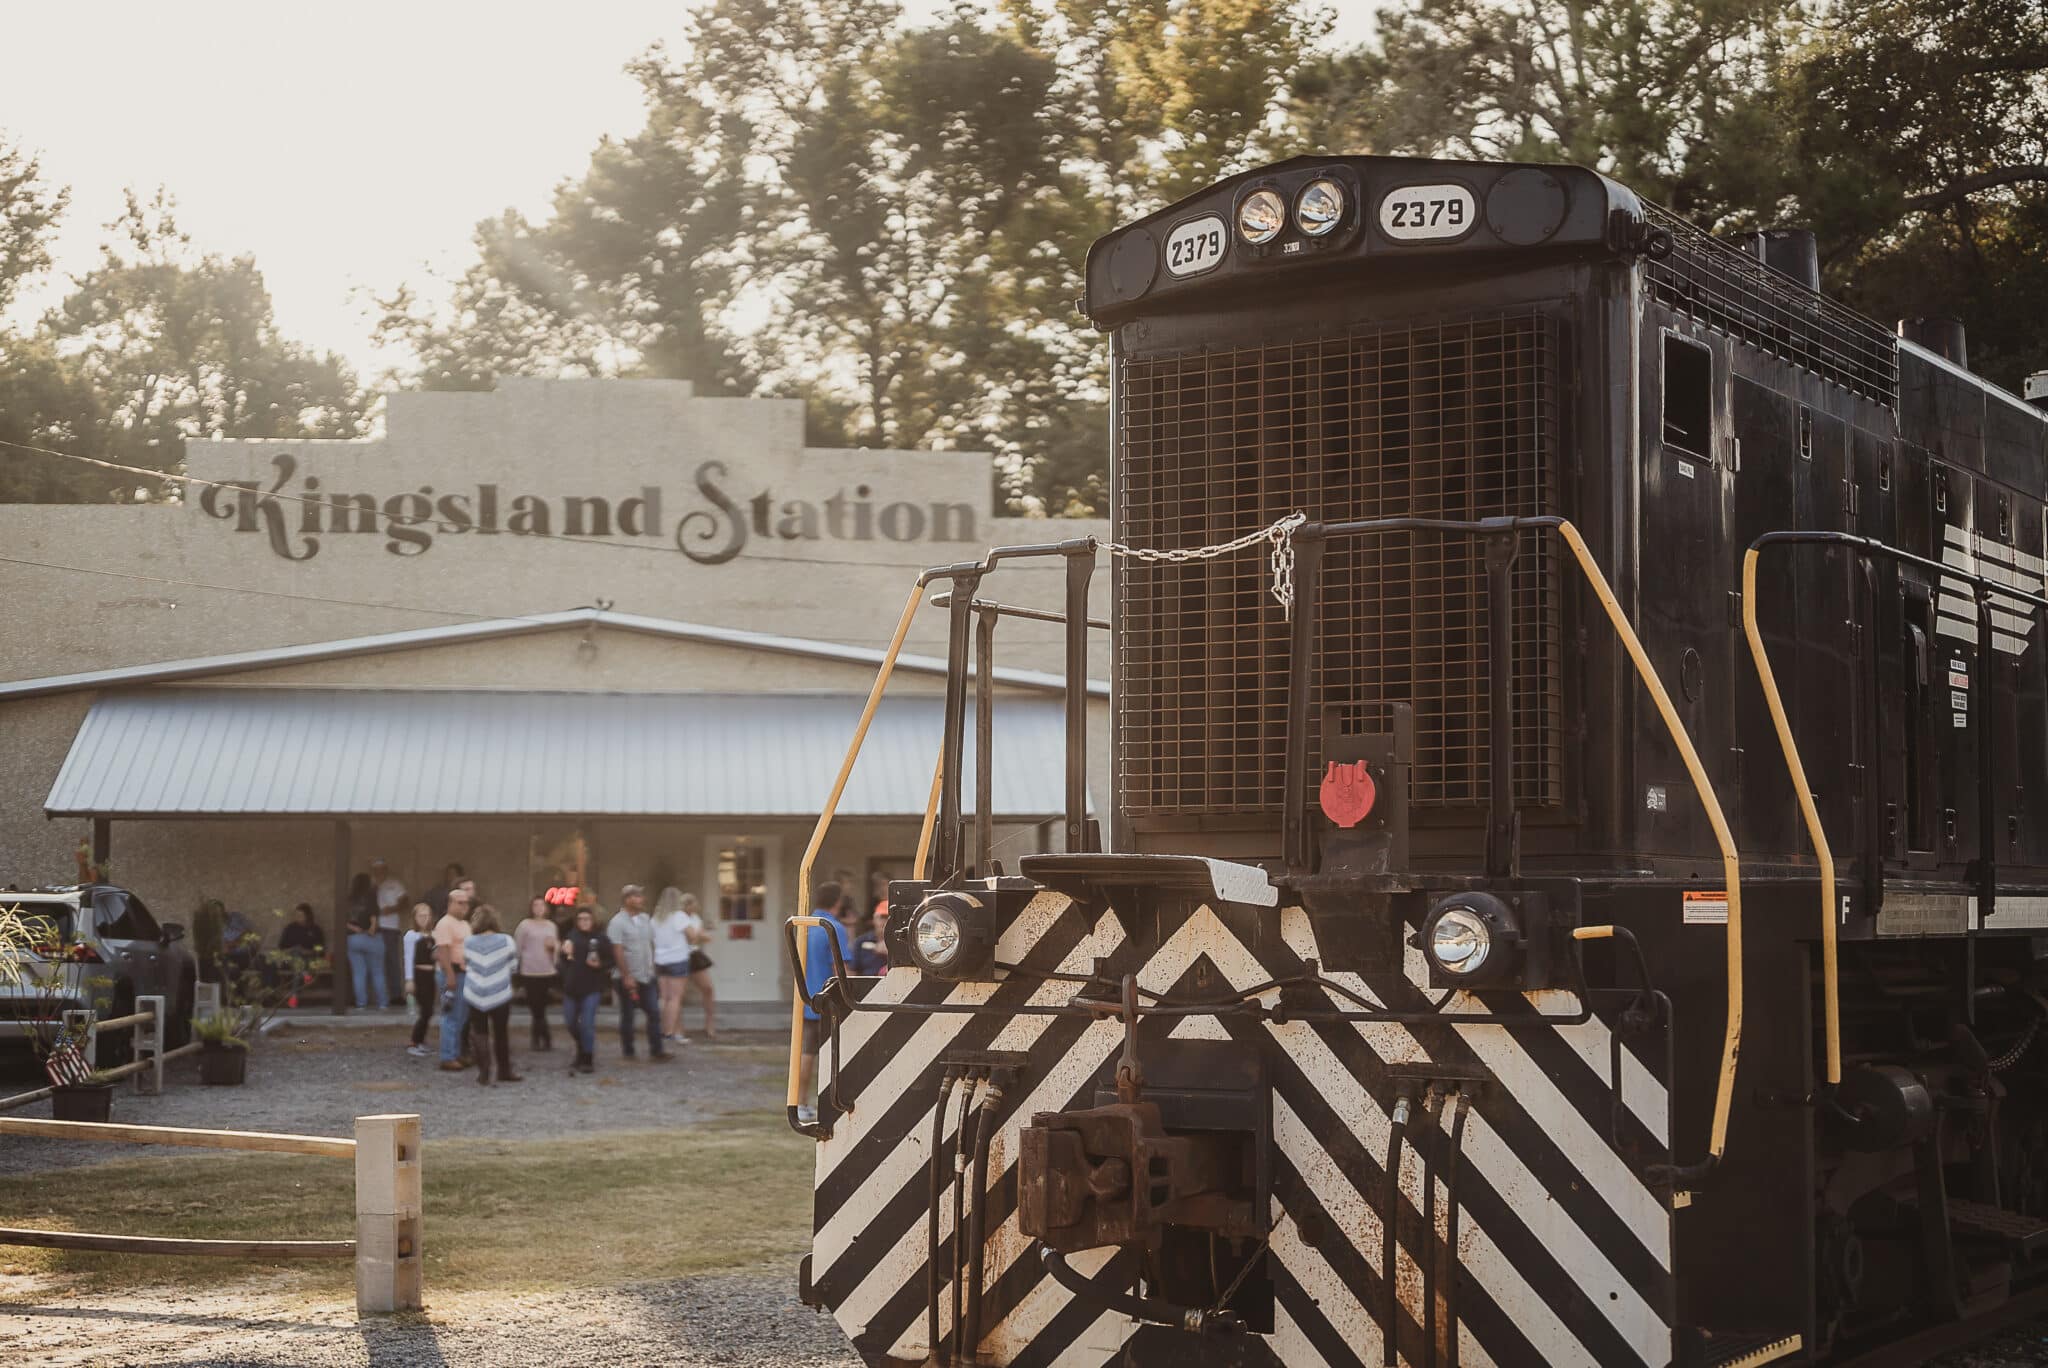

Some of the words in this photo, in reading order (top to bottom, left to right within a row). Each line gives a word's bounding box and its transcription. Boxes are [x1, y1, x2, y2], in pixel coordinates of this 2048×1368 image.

[1392, 199, 1463, 227] 2379
[1172, 231, 1219, 267] 2379
[200, 453, 665, 561] Kingsland
[677, 460, 979, 564] Station
[545, 887, 581, 905] OPE
[1842, 896, 1851, 925] F
